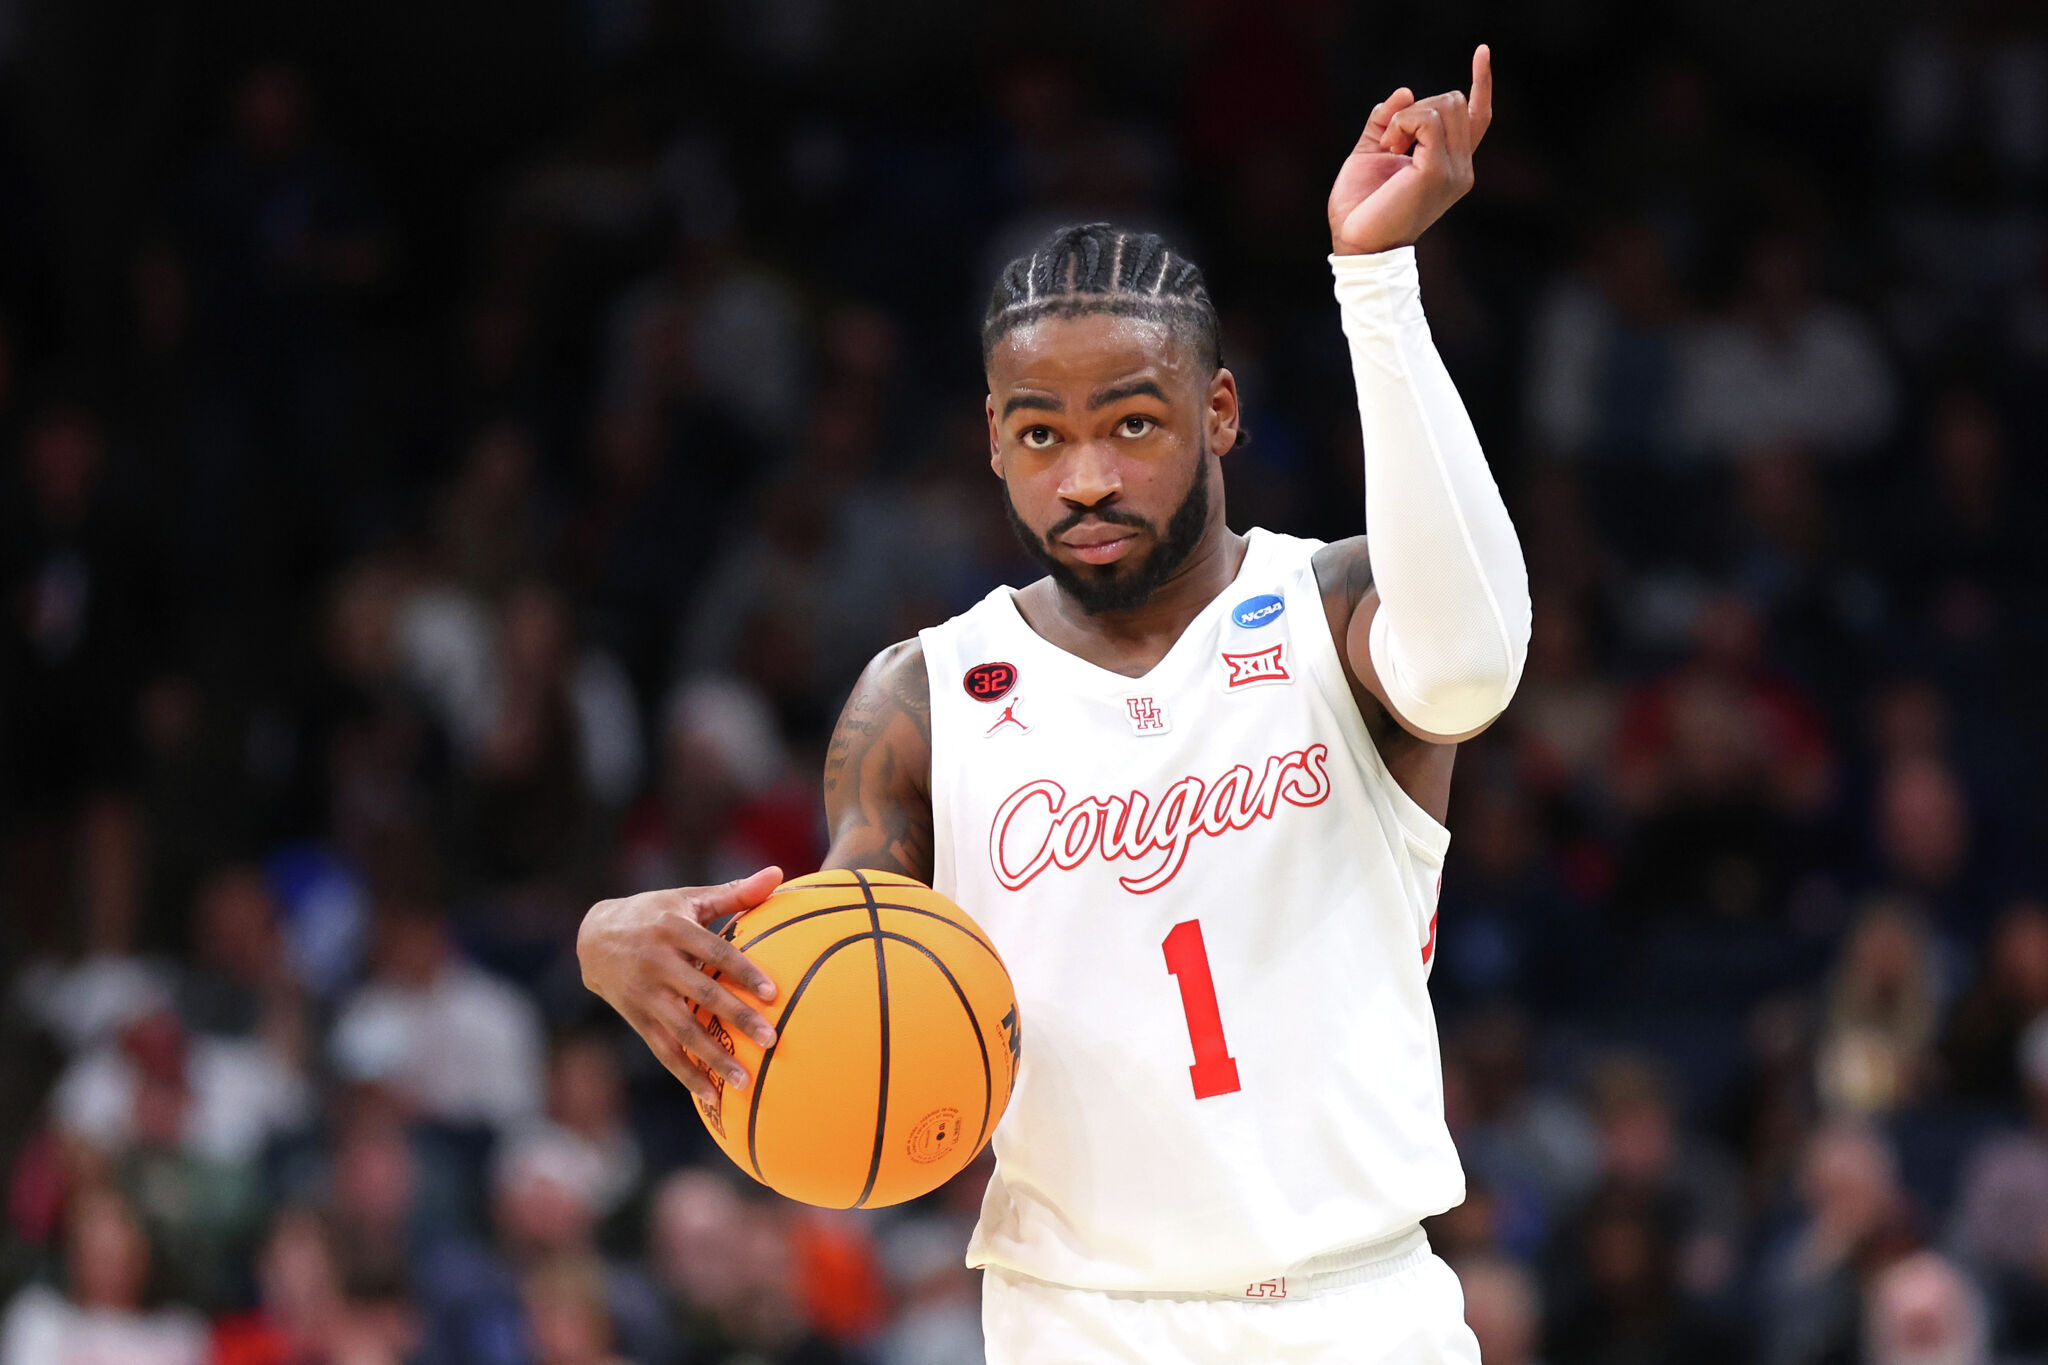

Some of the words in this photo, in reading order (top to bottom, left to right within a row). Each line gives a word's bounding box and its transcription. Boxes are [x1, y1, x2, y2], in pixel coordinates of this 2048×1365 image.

[1241, 602, 1283, 624] NCAA
[974, 669, 1008, 693] 32
[1231, 648, 1284, 682] XII
[1126, 697, 1163, 729] UH
[990, 743, 1331, 895] Cougars
[1162, 918, 1241, 1100] 1
